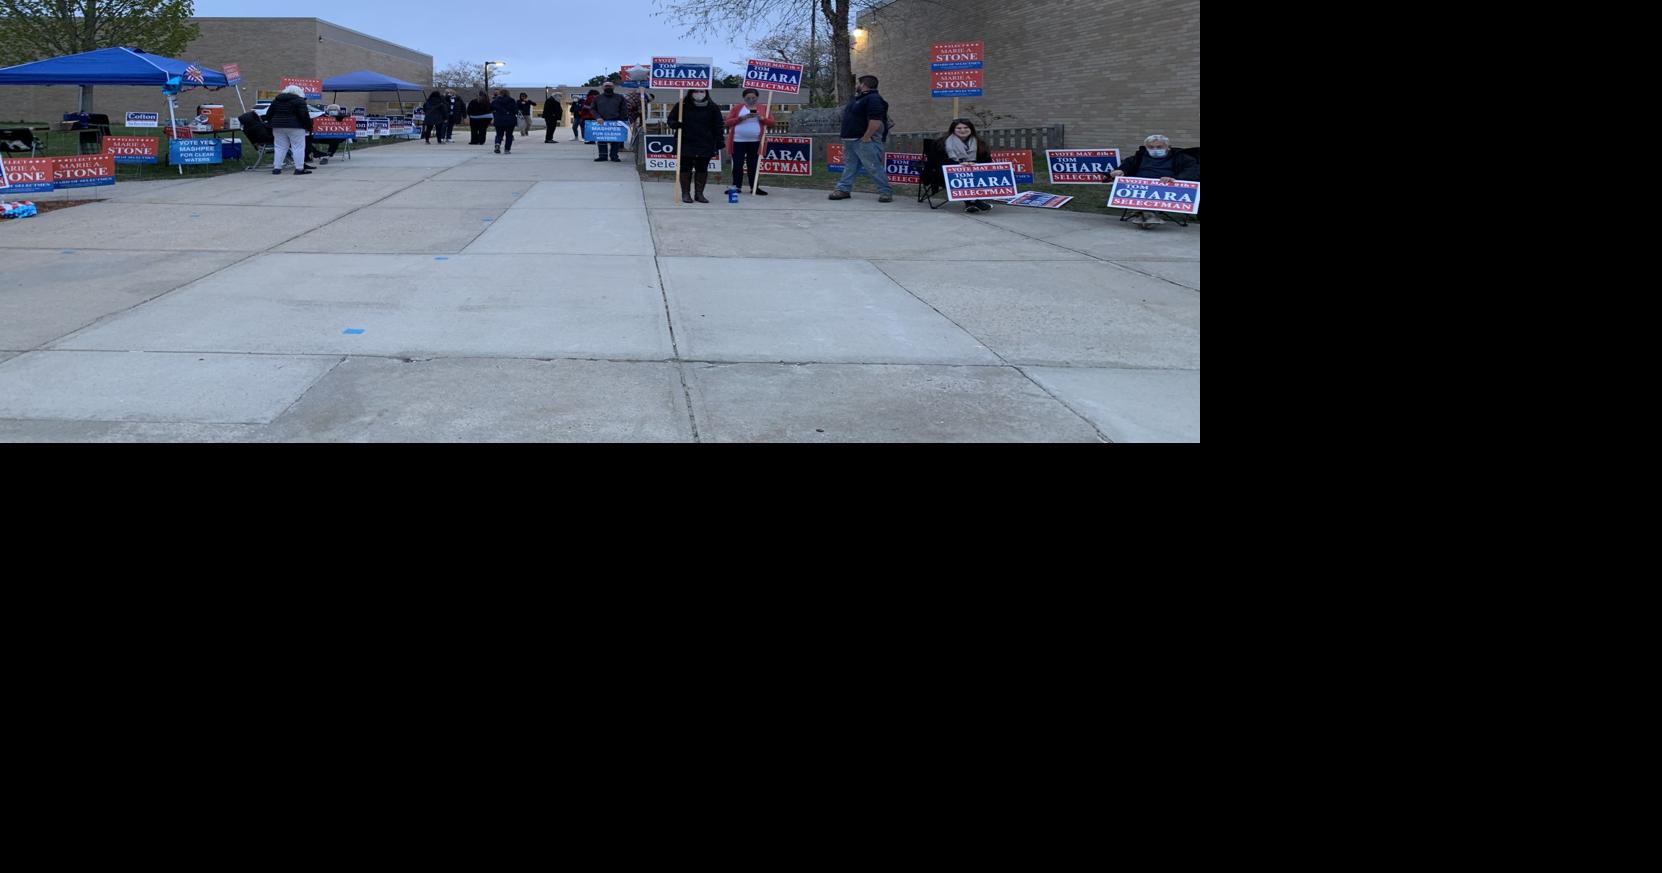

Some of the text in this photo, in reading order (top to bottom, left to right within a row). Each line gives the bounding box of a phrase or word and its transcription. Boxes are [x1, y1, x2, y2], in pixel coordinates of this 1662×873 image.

[936, 53, 978, 62] STONE
[653, 79, 708, 87] SELECTMAN
[745, 80, 798, 92] SELECTMAN
[936, 80, 977, 89] STONE
[107, 147, 152, 155] STONE
[765, 149, 807, 161] ARA
[53, 167, 109, 179] STONE
[952, 188, 1013, 197] SELECTMAN
[1112, 198, 1192, 210] SELECTMAN
